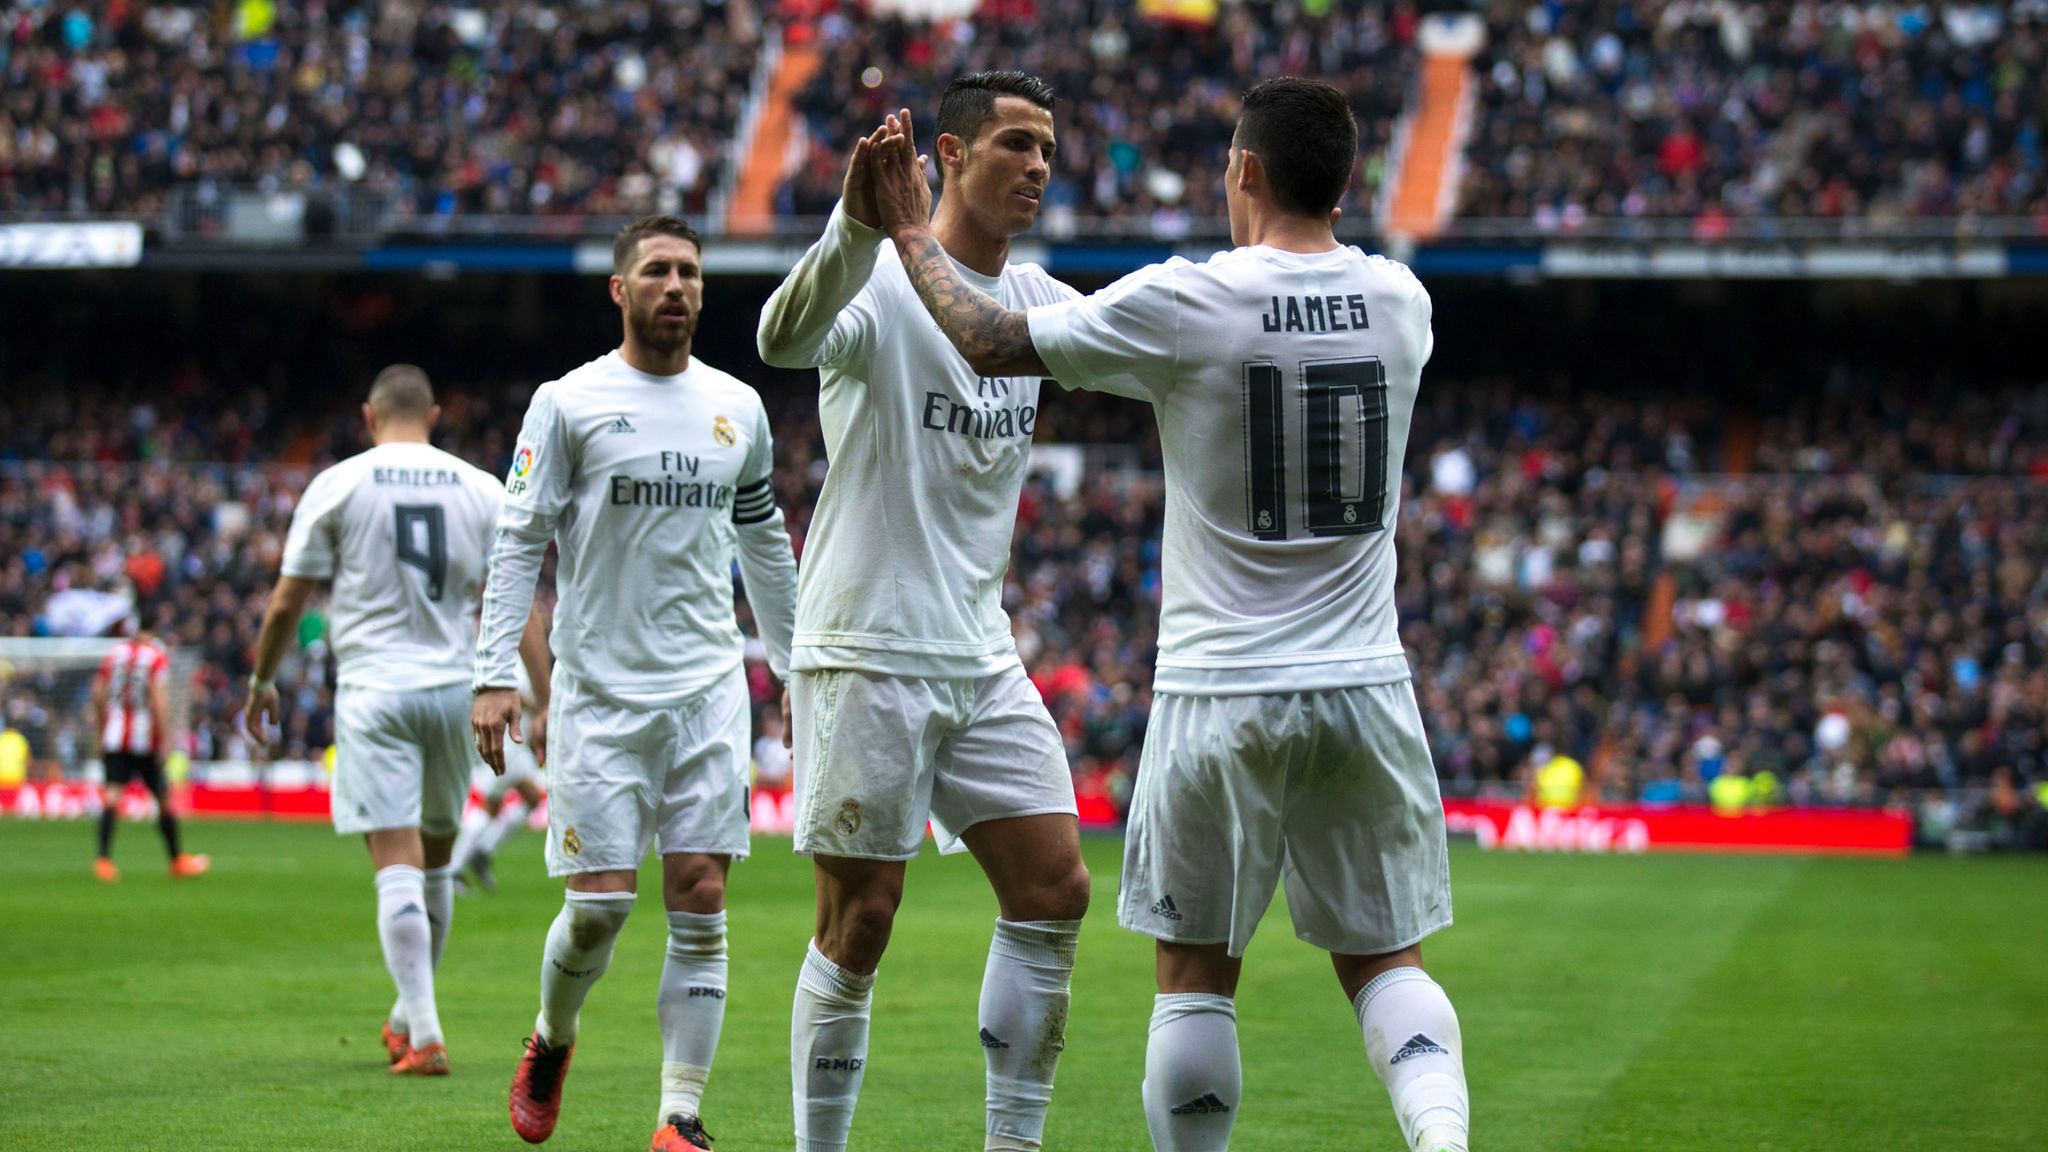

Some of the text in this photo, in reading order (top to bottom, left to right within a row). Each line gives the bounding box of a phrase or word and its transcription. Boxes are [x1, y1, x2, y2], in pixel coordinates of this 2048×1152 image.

[1262, 294, 1369, 332] JAMES
[1243, 356, 1388, 540] 10
[661, 450, 699, 477] Fly
[508, 478, 526, 496] LFP
[394, 503, 446, 602] 9
[1151, 905, 1183, 921] adidas
[689, 986, 726, 999] RMC
[1390, 1046, 1449, 1065] adidas
[1171, 1104, 1230, 1115] adidas
